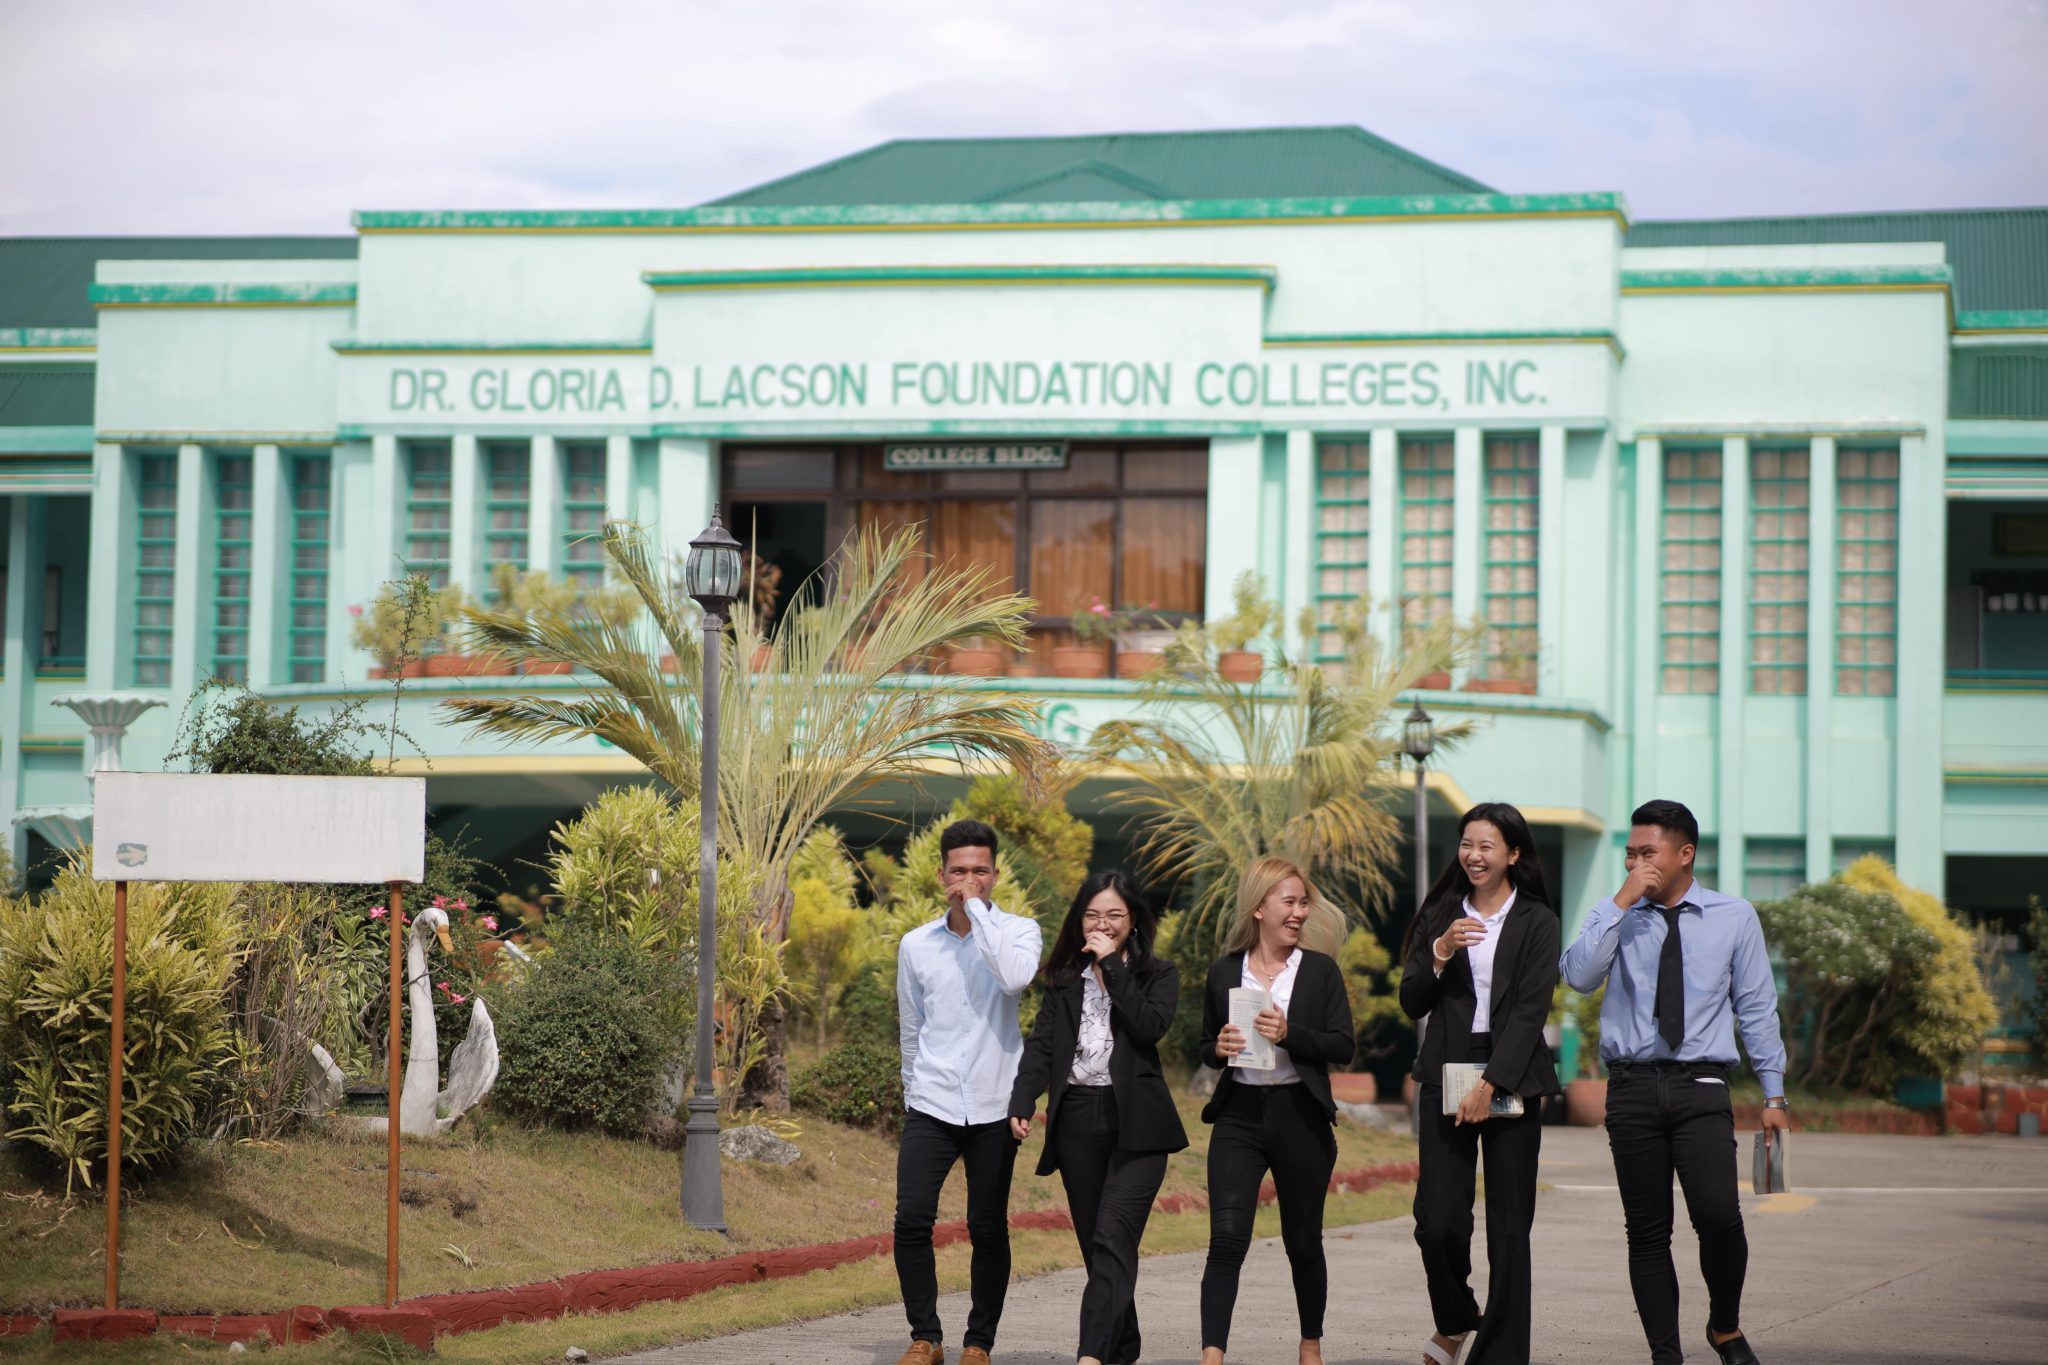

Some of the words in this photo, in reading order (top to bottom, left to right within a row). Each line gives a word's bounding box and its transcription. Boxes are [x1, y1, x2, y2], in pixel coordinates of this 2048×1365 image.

[390, 367, 454, 411] DR.
[470, 367, 625, 411] GLORIA
[650, 365, 679, 410] D.
[694, 363, 867, 408] LACSON
[892, 361, 1170, 405] FOUNDATION
[1196, 361, 1449, 410] COLLEGES,
[1465, 359, 1547, 405] INC.
[891, 447, 990, 465] COLLEGE
[994, 446, 1060, 464] BLDG.
